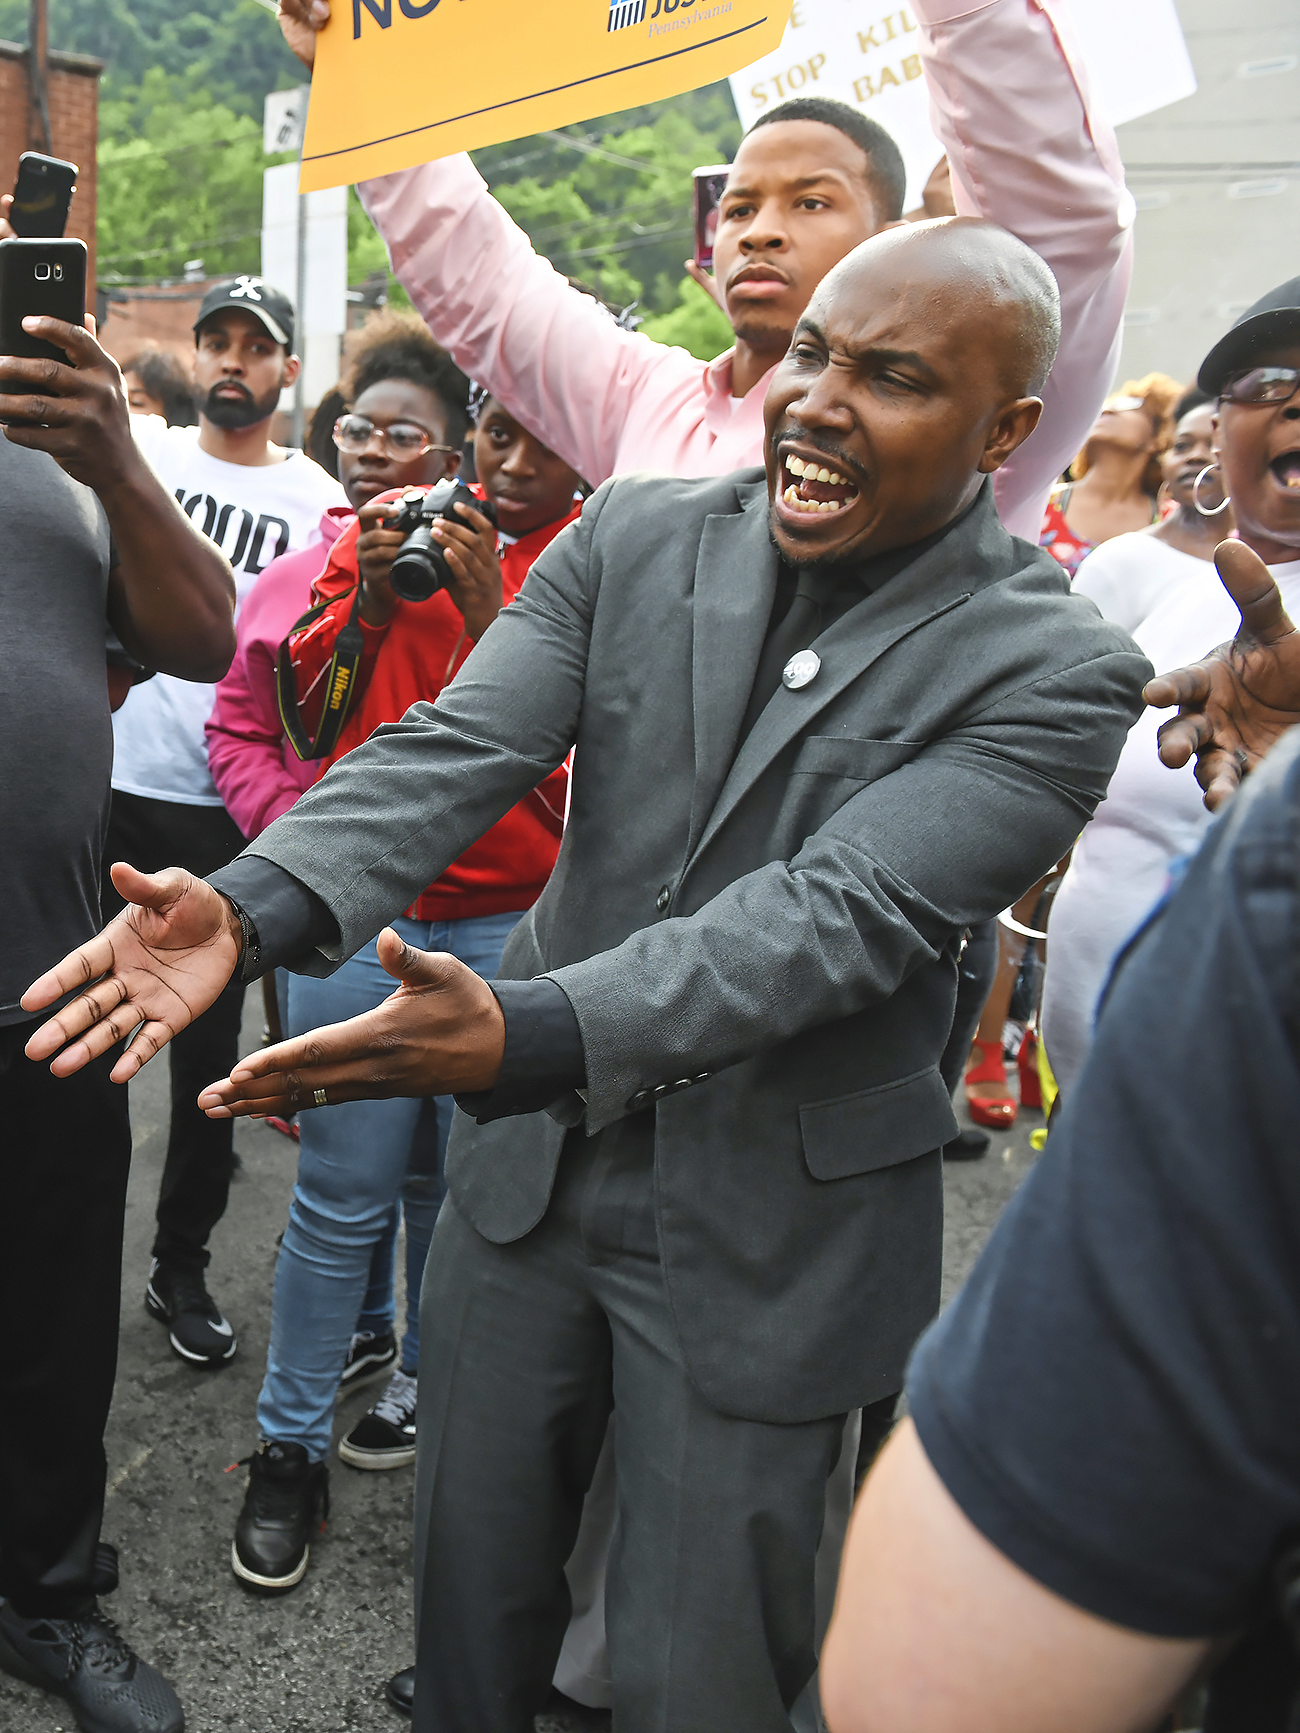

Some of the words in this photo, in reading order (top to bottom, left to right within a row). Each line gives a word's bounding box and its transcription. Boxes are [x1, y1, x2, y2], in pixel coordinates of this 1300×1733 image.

[647, 1, 733, 38] Pennsylvania
[750, 52, 826, 109] STOP
[330, 665, 351, 710] Nikon
